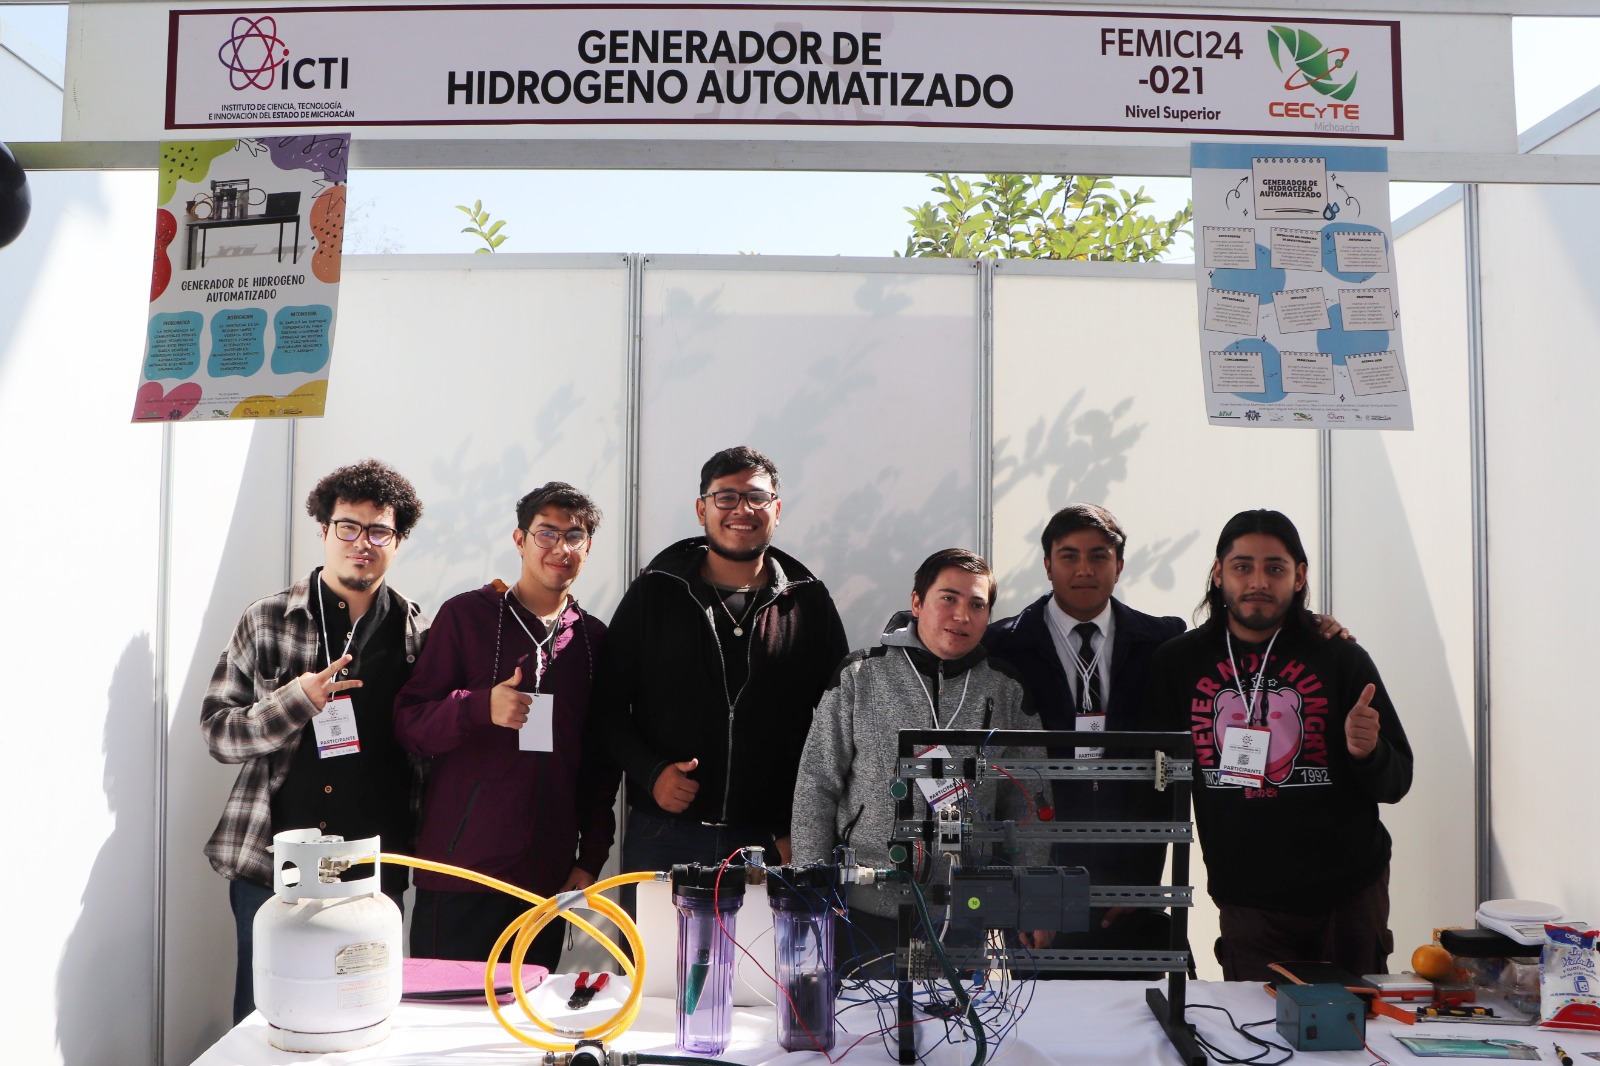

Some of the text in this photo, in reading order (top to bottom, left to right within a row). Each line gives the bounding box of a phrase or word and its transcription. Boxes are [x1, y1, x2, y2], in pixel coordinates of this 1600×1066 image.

[578, 30, 882, 65] GENERADOR DE
[1100, 28, 1243, 59] FEMICI24
[1138, 65, 1203, 94] -021
[447, 70, 1014, 108] HIDROGENO AUTOMATIZADO
[221, 103, 255, 111] INSTITUTO
[266, 102, 296, 111] CIENCIA,
[298, 101, 342, 110] TECNOLOGÍA
[1125, 105, 1221, 122] Nivel Superior
[214, 111, 258, 120] INNOVACIÓN
[272, 111, 299, 119] ESTADO
[310, 109, 354, 118] MICHOACÁN
[1314, 122, 1360, 132] Michoacán
[181, 275, 305, 291] GENERADOR DE HIDROGENO
[206, 289, 277, 302] AUTOMATIZADO
[1191, 676, 1222, 766] NEVER
[1279, 659, 1329, 766] HUNGRY
[320, 735, 356, 746] PARTICIPANTE
[1223, 764, 1263, 775] PARTICIPANTE
[1300, 769, 1331, 783] 1992
